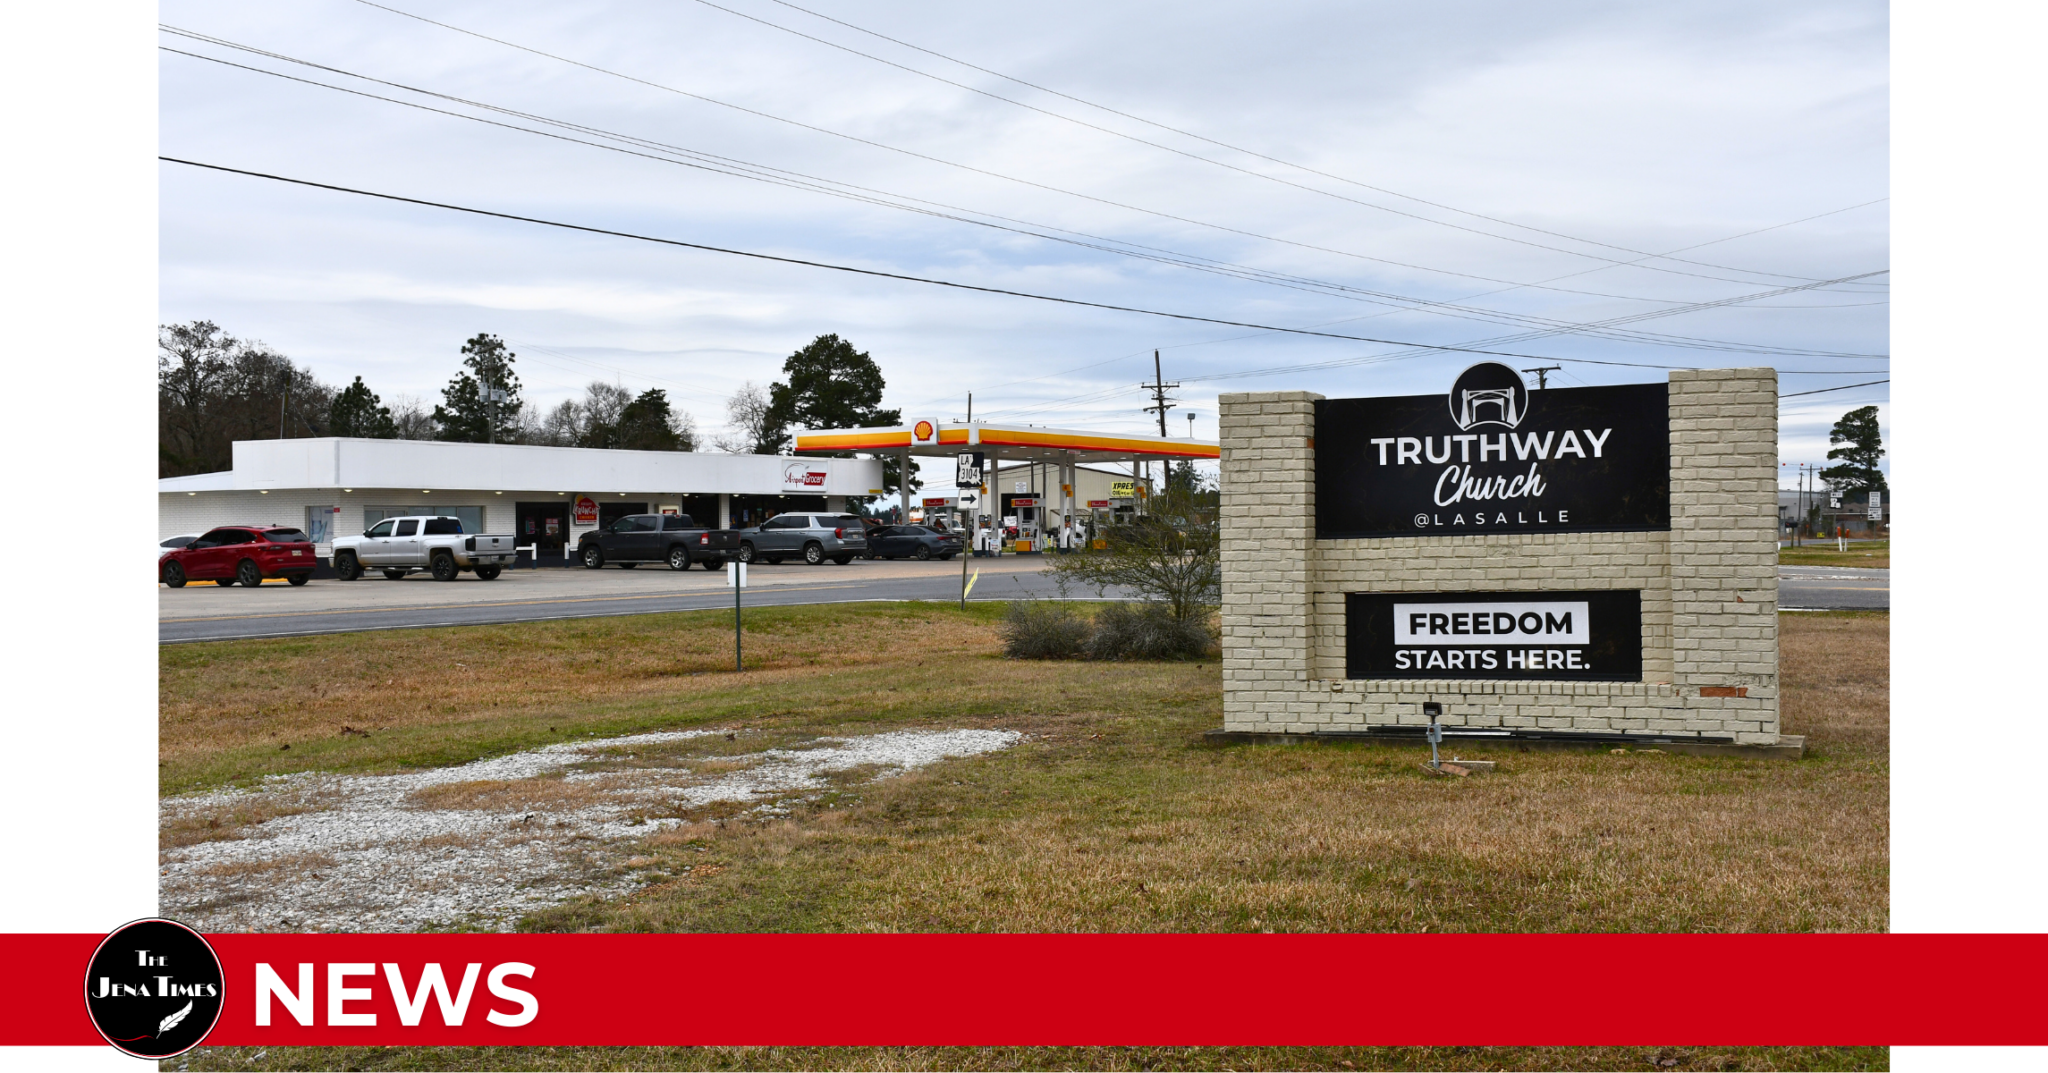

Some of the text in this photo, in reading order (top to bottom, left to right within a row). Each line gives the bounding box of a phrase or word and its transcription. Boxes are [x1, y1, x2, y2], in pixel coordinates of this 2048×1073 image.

[1370, 429, 1612, 466] TRUTHWAY
[960, 455, 969, 465] LA
[805, 473, 826, 486] Grocery
[961, 468, 978, 480] 3104
[1433, 461, 1547, 507] Church
[1414, 511, 1569, 528] @LASALLE
[1409, 611, 1573, 636] FREEDOM
[1395, 649, 1591, 670] STARTS HERE.
